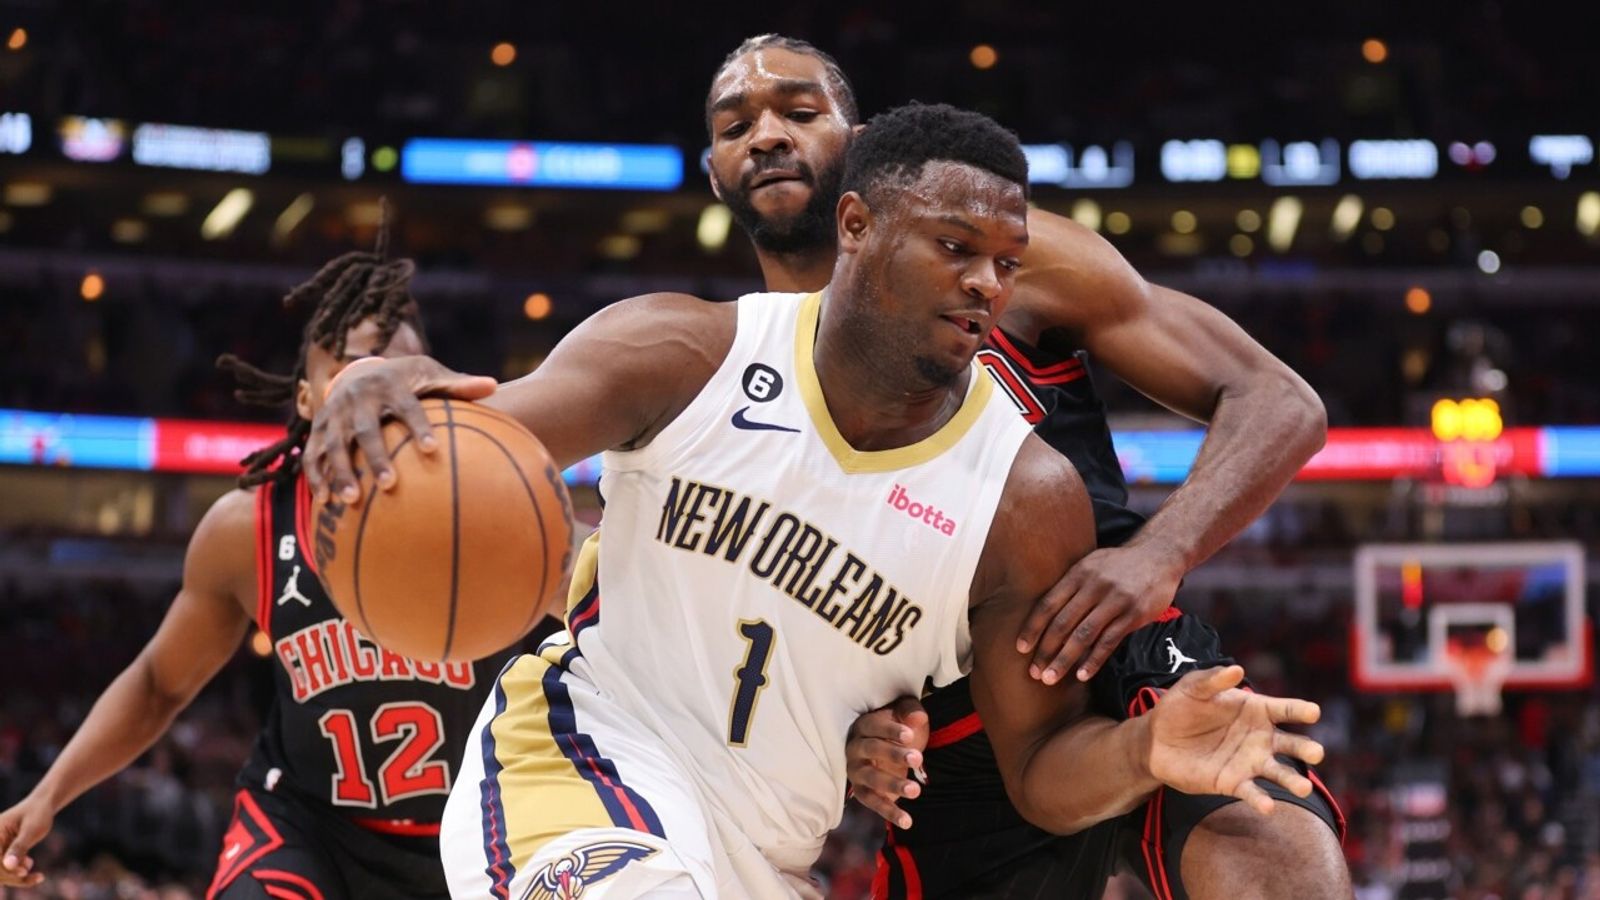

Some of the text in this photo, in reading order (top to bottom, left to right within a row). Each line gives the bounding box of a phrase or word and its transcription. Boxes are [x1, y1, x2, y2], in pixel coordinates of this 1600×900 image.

[748, 369, 775, 398] 6
[279, 535, 296, 560] 6
[886, 483, 957, 537] ibotta
[655, 475, 771, 564] NEW
[748, 511, 924, 657] ORLEANS
[727, 617, 777, 748] 1
[318, 701, 451, 809] 12
